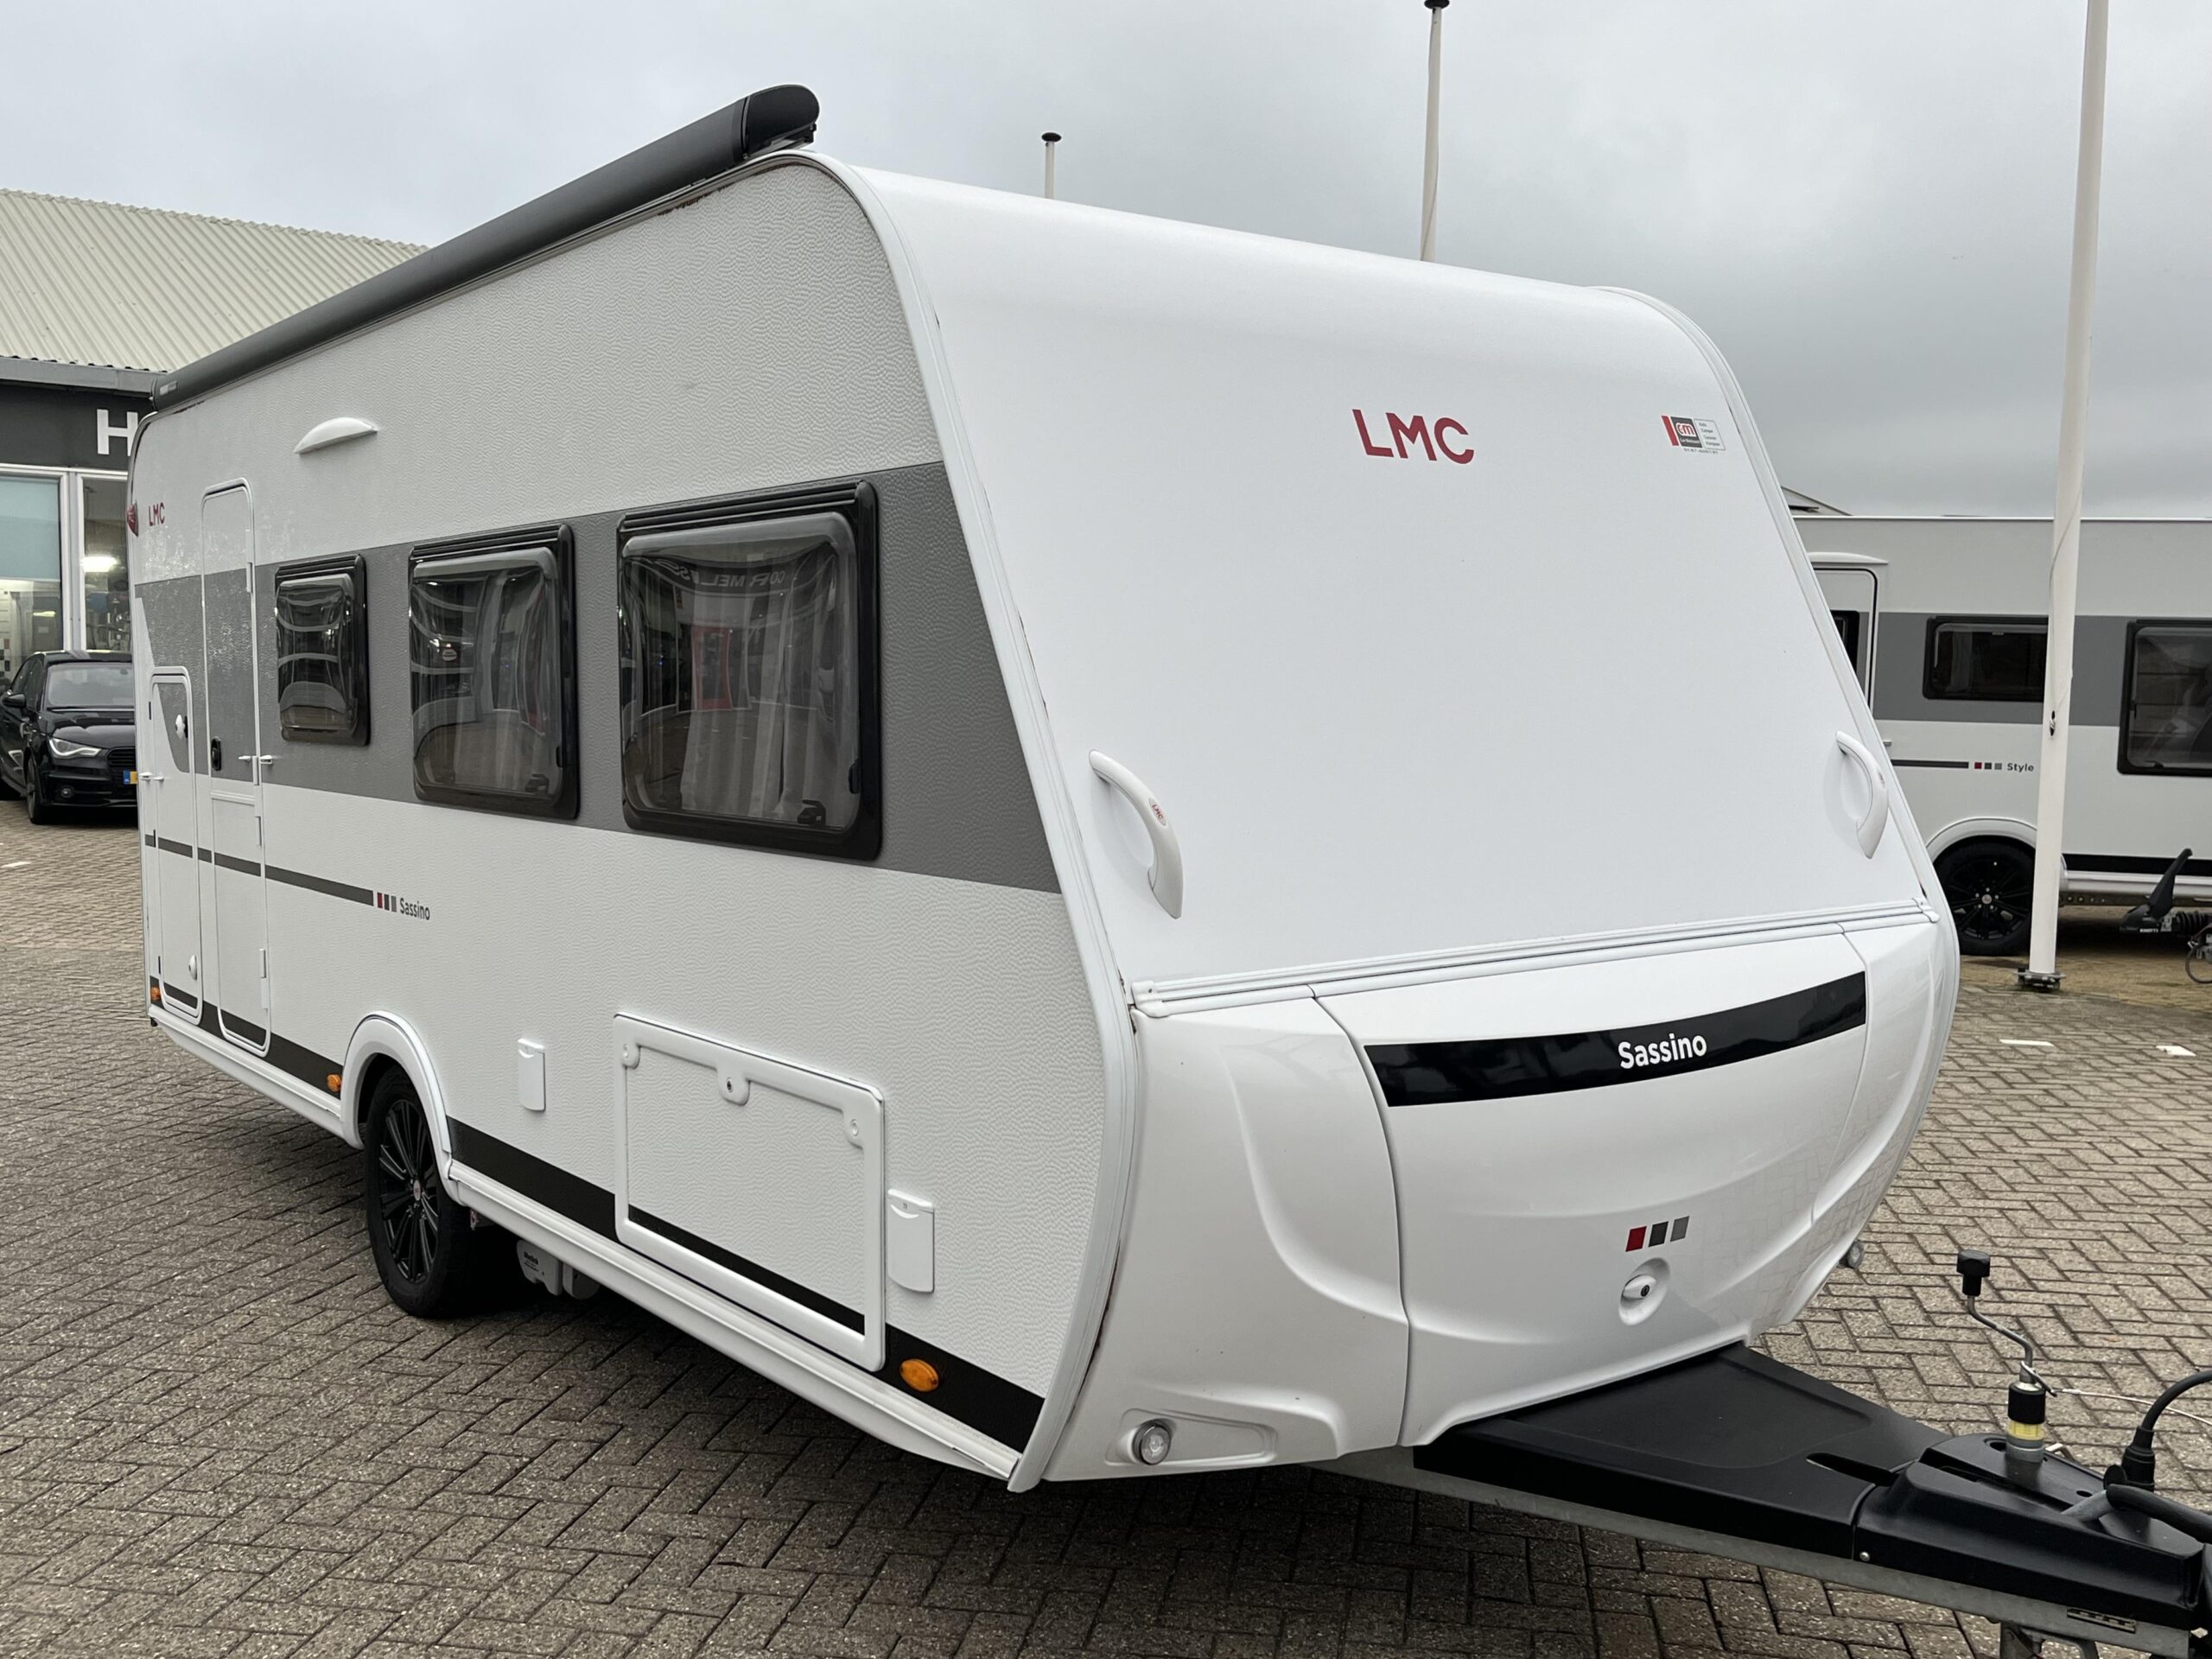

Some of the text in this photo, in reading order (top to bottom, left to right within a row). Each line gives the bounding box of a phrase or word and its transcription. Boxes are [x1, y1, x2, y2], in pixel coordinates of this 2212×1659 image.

[1352, 409, 1474, 465] LMC
[149, 502, 165, 526] LMC
[2006, 762, 2034, 773] Style
[399, 897, 430, 921] Sassino
[1618, 1033, 1707, 1070] Sassino
